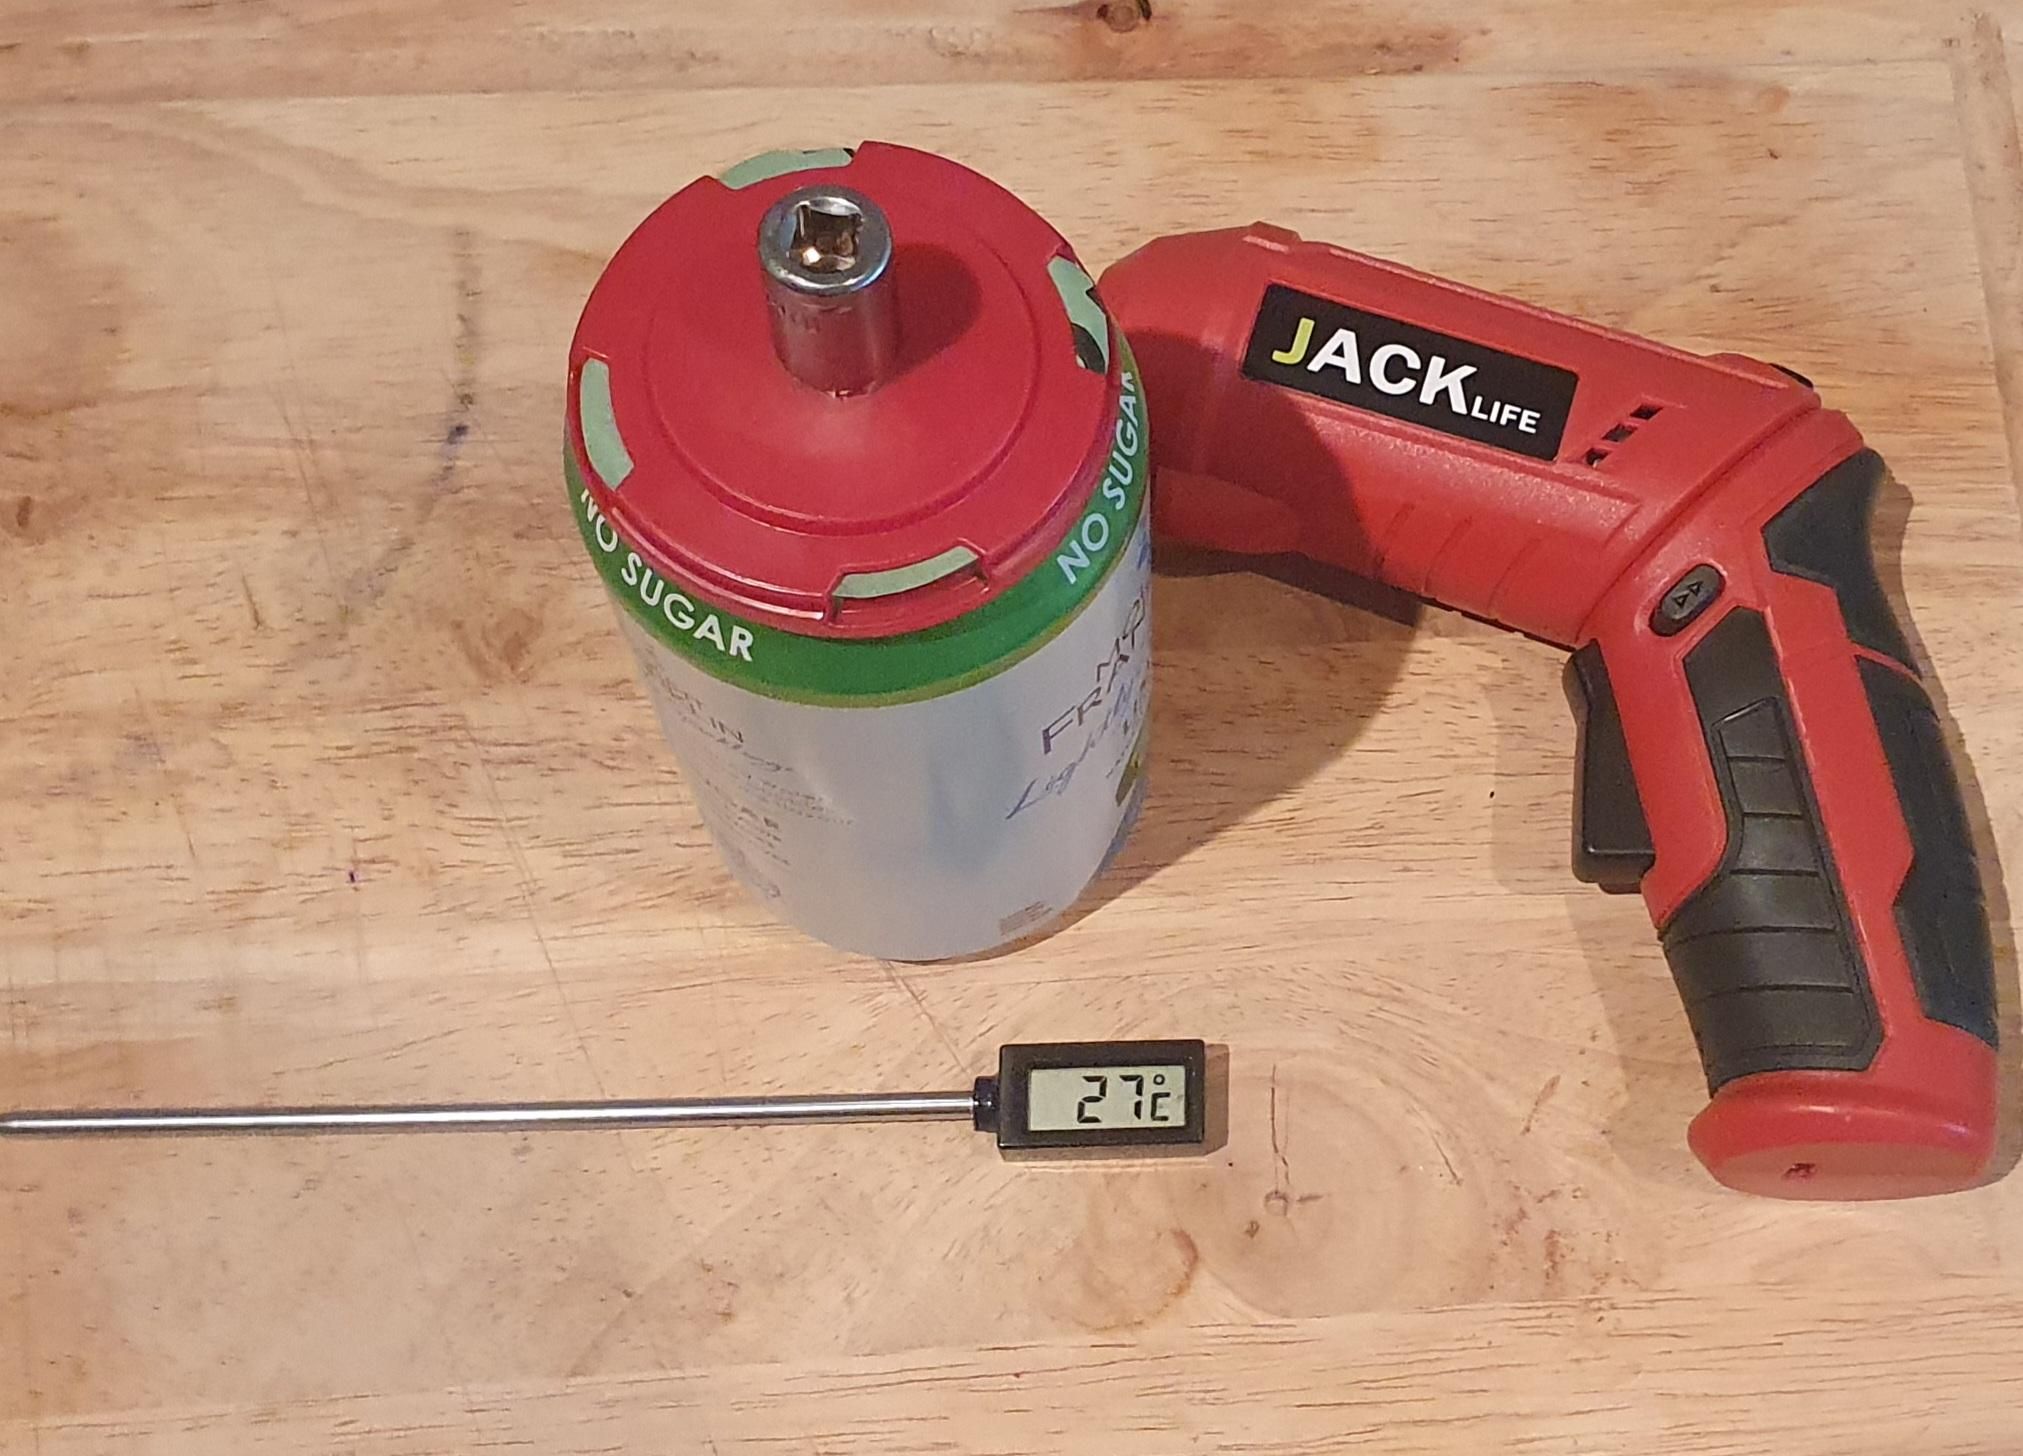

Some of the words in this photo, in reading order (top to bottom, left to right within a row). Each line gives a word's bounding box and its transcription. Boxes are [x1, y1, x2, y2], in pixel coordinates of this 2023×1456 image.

[1271, 317, 1478, 416] JACK
[1470, 395, 1541, 434] LIFE
[1057, 513, 1109, 584] NO
[621, 552, 753, 661] SUGAR
